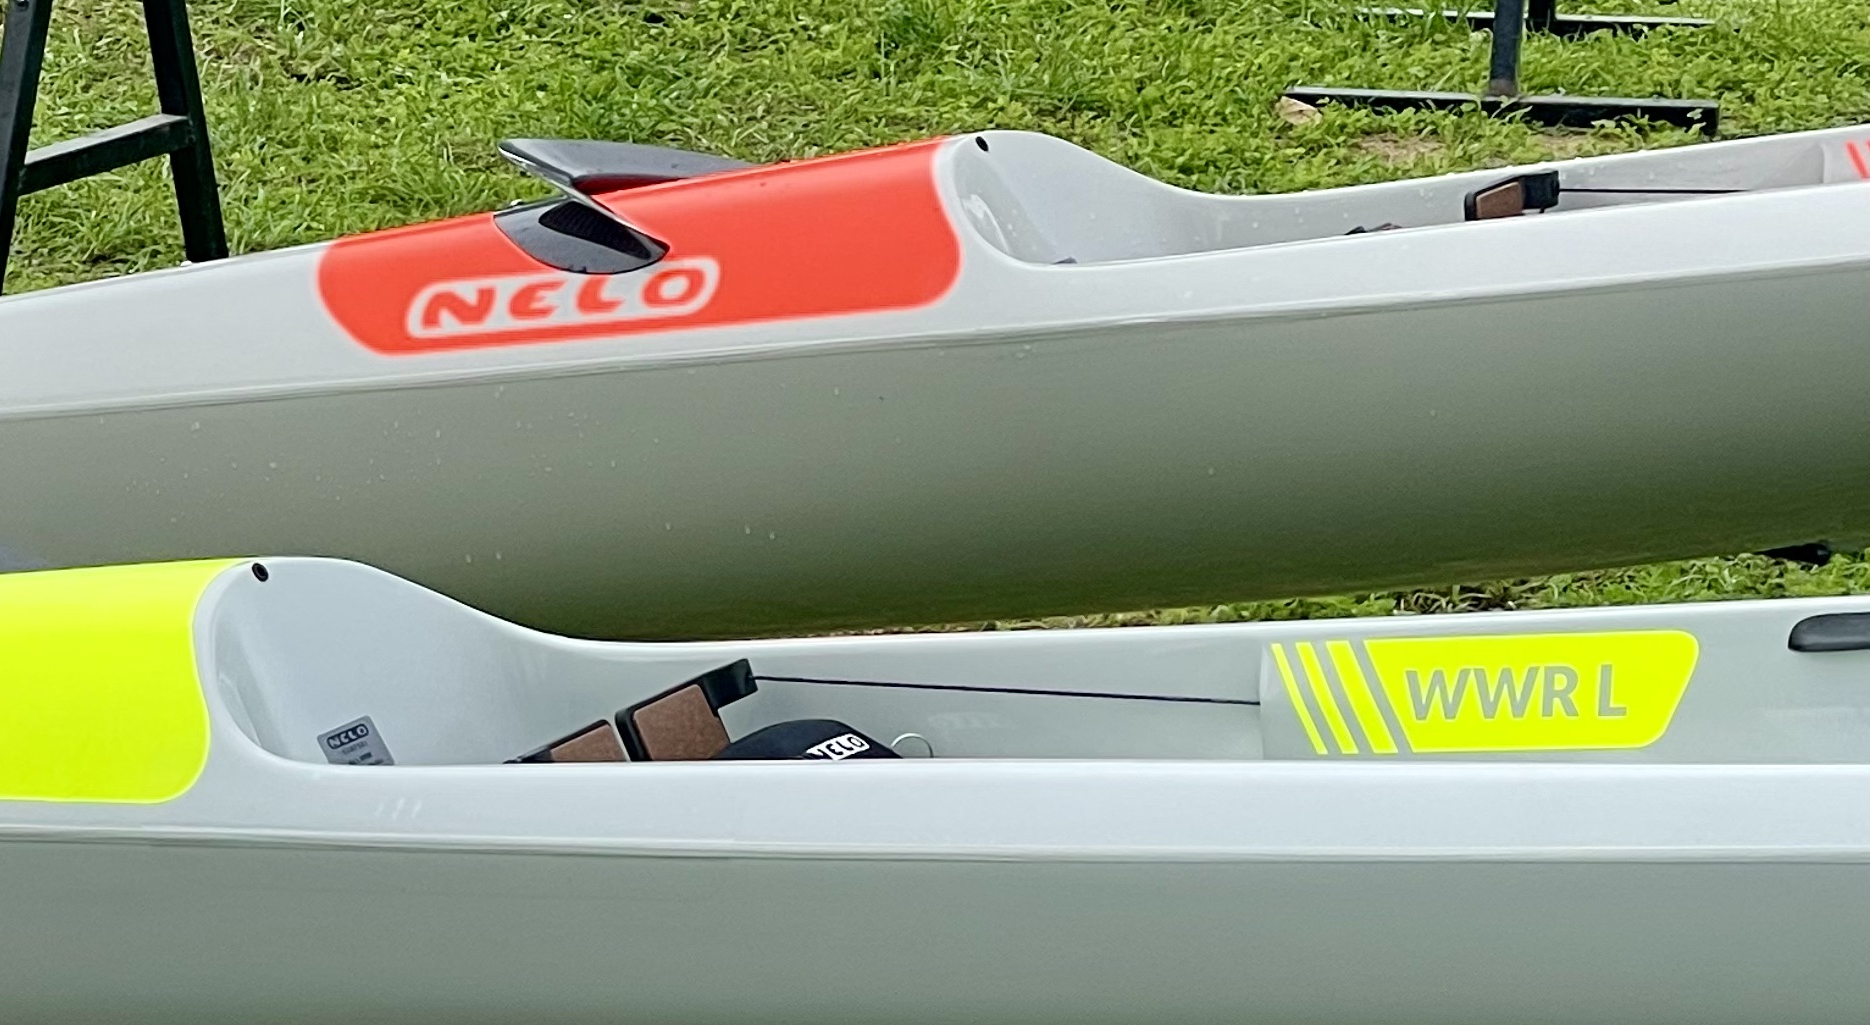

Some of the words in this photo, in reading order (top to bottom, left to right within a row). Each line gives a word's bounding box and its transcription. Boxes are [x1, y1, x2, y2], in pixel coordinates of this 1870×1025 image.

[420, 268, 707, 330] NELO
[1404, 665, 1580, 721] WWR
[1597, 664, 1628, 718] L
[328, 725, 368, 748] NELO
